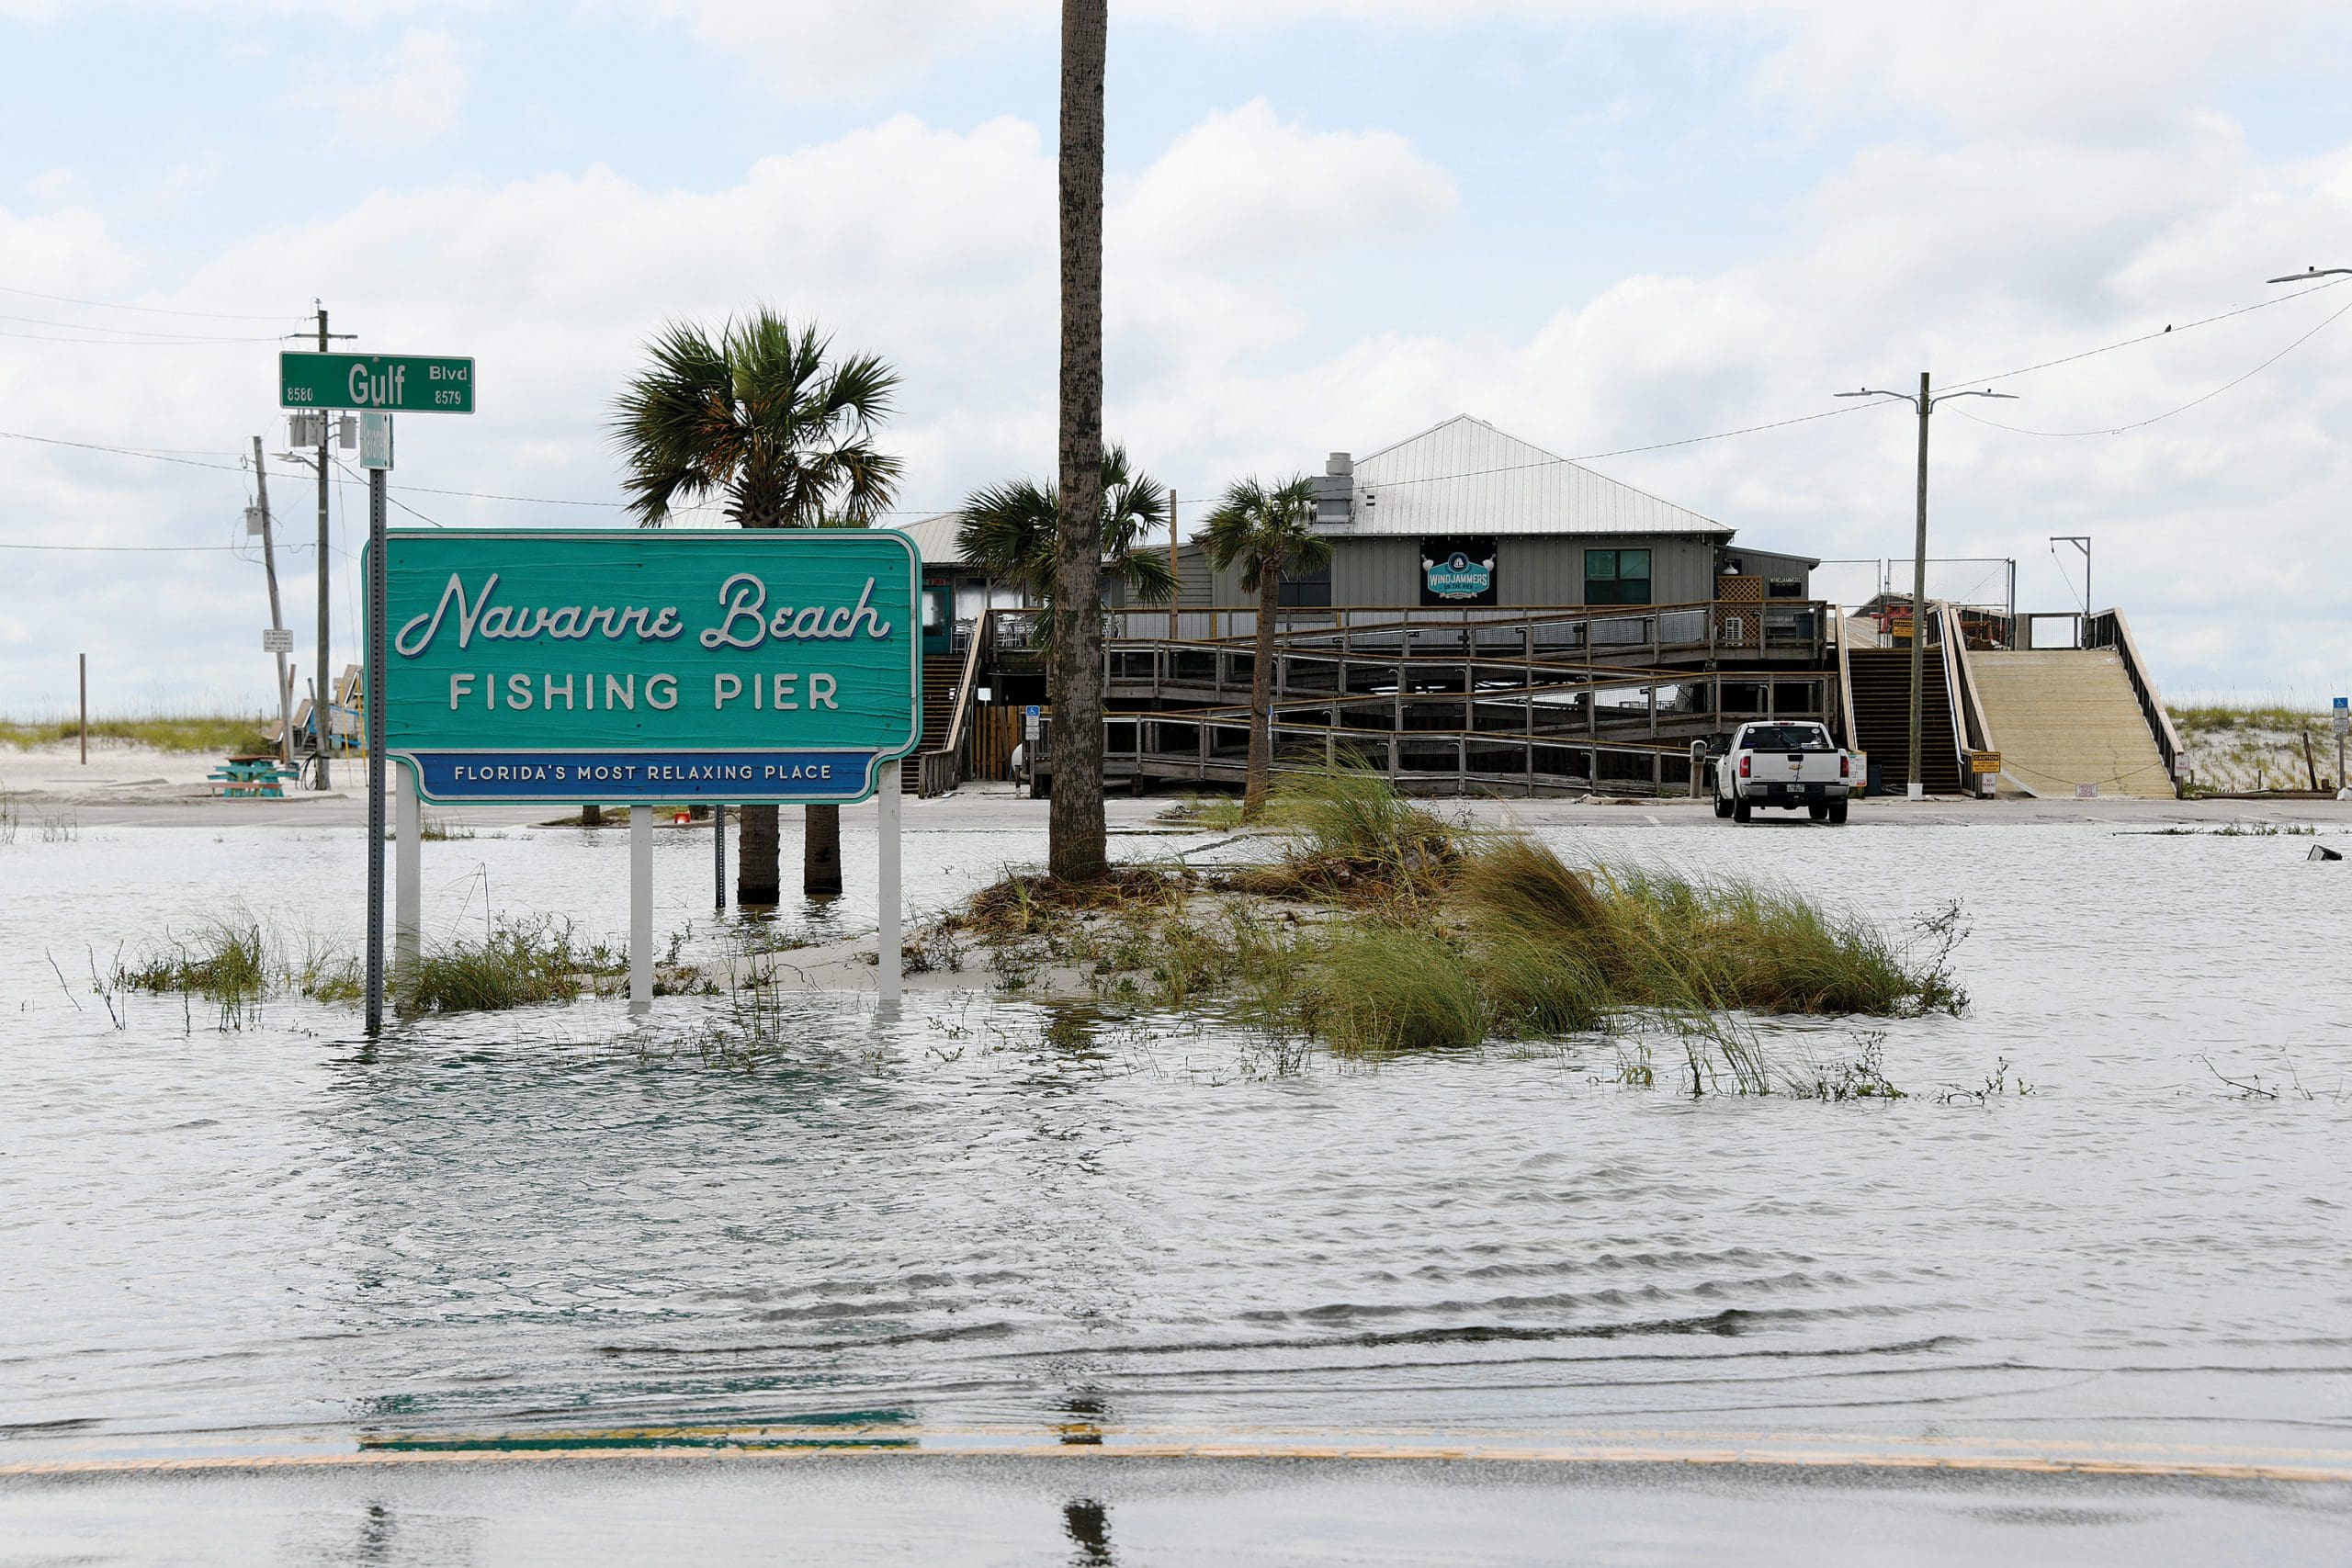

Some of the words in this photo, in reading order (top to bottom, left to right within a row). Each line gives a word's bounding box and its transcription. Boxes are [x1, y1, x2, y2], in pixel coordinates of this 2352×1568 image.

[429, 366, 468, 380] Blvd
[348, 363, 406, 405] Gulf
[287, 387, 313, 402] 8580
[435, 390, 461, 405] 8579
[1430, 574, 1487, 586] WINDJAMMERS
[394, 571, 684, 660] Navarre
[699, 572, 892, 651] Beach
[449, 672, 678, 711] FISHING
[714, 672, 839, 710] PIER
[454, 765, 567, 782] FLORIDA'S
[577, 765, 637, 781] MOST
[647, 765, 753, 781] RELAXING
[764, 765, 831, 781] PLACE
